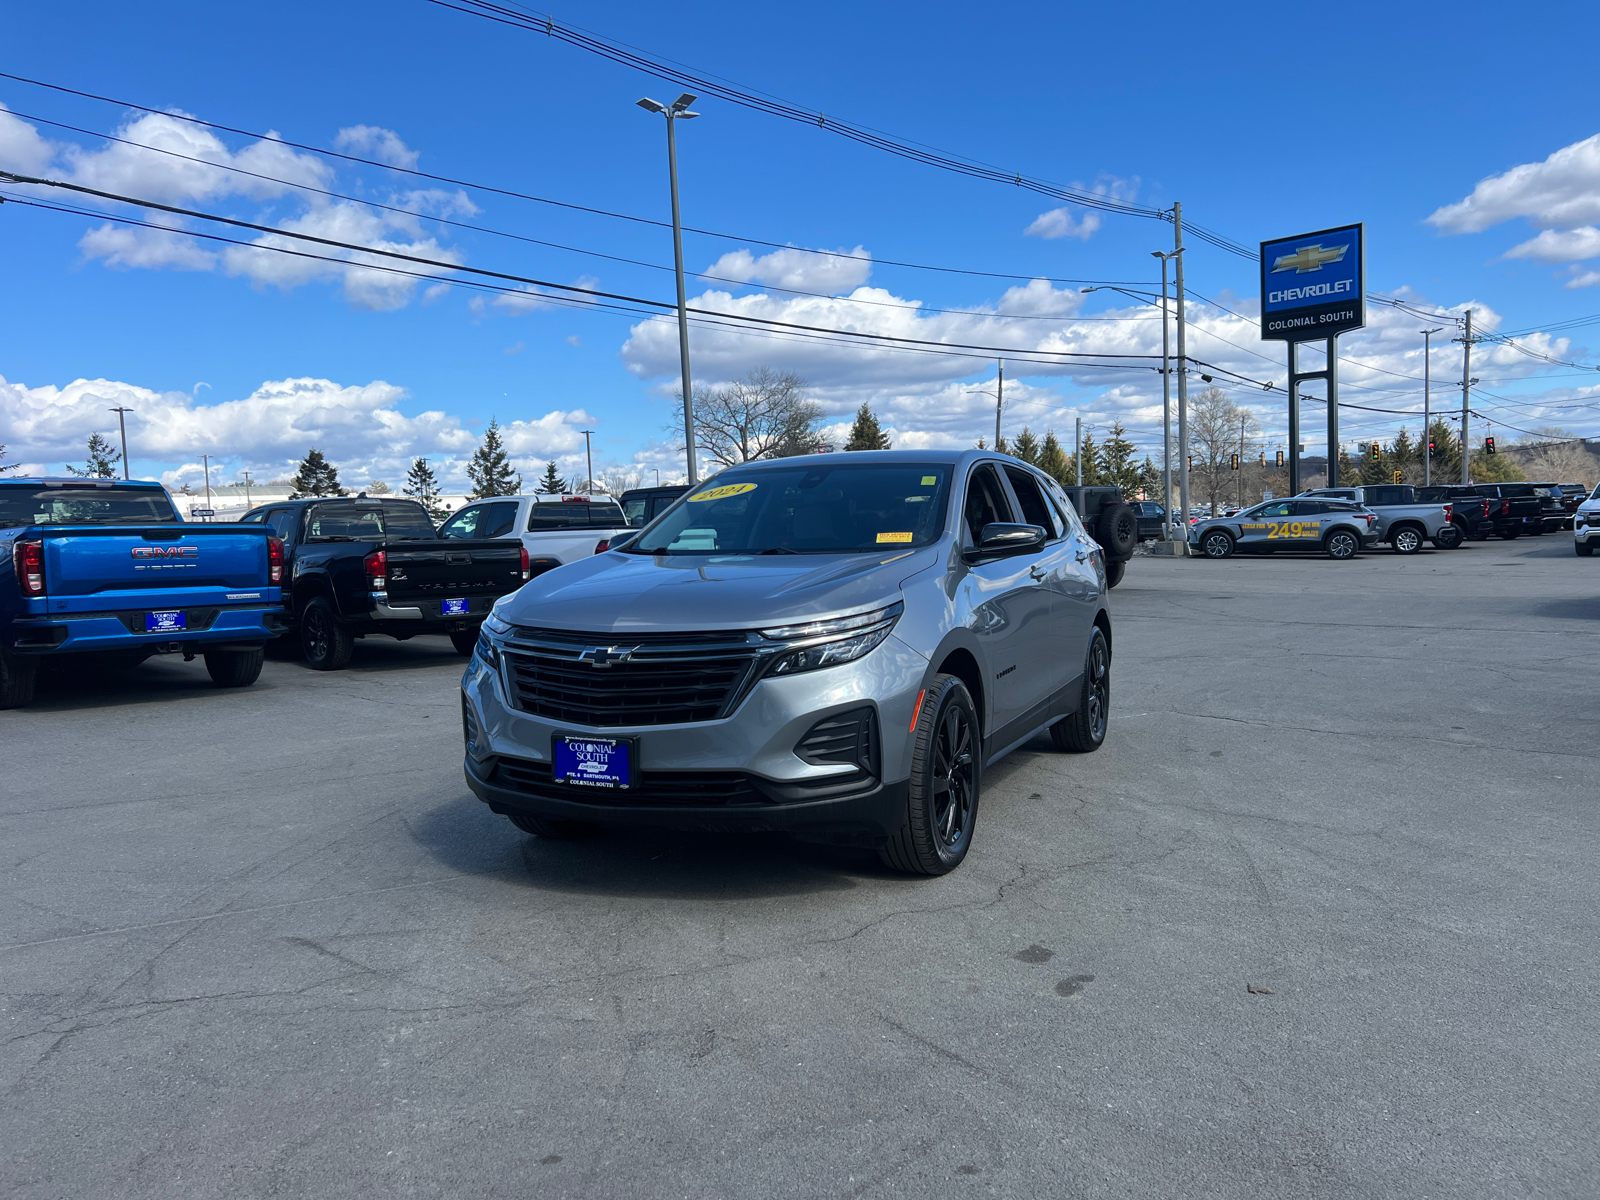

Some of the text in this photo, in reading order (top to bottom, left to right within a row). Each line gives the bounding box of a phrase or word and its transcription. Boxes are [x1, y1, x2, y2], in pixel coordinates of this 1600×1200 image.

[1269, 279, 1353, 304] CHEVROLET
[1269, 310, 1354, 330] COLONIAL SOUTH
[697, 485, 747, 500] 2024
[132, 546, 198, 559] GMC
[419, 581, 495, 590] TACOMA
[569, 742, 615, 754] COLONIAL
[576, 752, 608, 762] SOUTH
